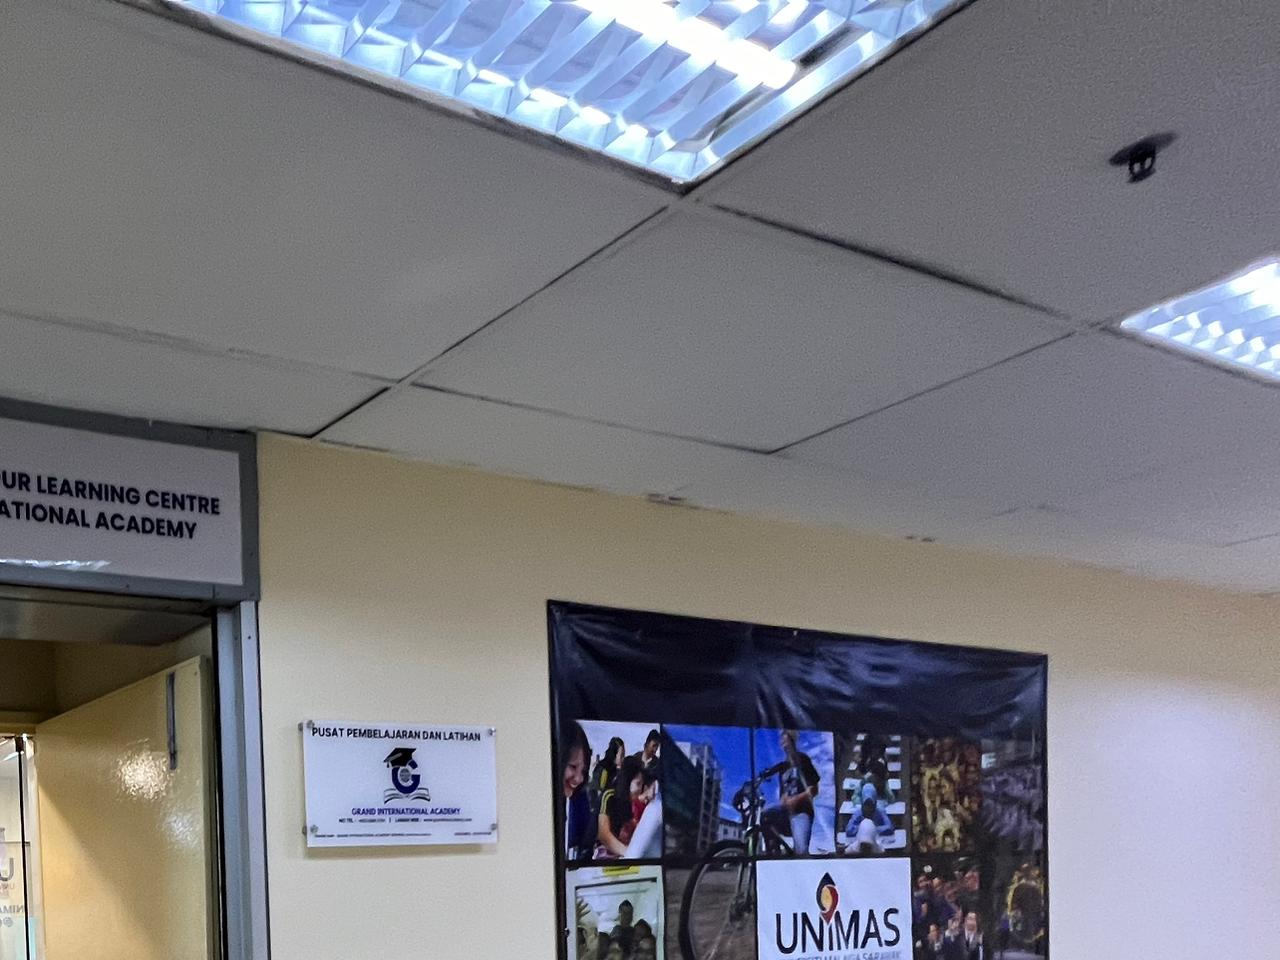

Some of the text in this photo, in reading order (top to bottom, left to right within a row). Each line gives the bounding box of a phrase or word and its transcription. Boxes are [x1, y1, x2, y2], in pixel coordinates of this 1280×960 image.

[36, 475, 141, 506] LEARNING
[145, 489, 221, 515] CENTRE
[95, 511, 197, 540] ACADEMY
[312, 727, 481, 741] PUSAT PEMBELAJARAN DAN LATIHAN
[776, 908, 900, 954] UNIMAS
